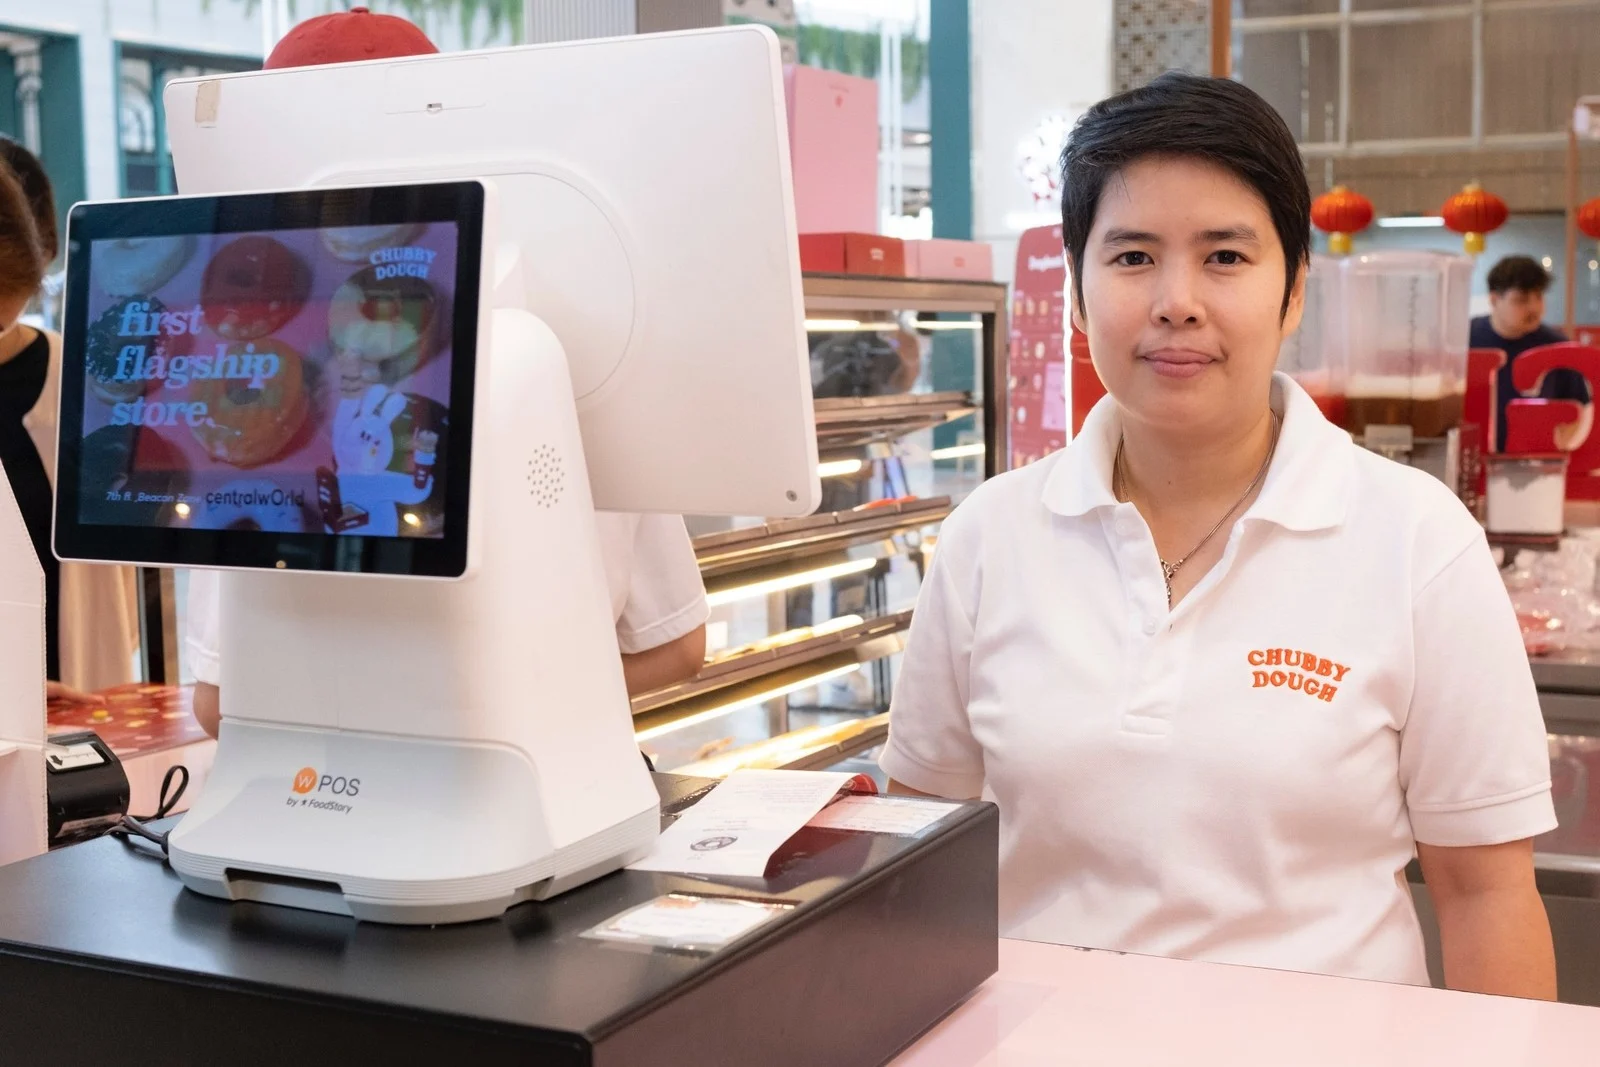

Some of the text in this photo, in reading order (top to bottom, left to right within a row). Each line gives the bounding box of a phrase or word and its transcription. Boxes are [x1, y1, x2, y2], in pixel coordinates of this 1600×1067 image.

[369, 247, 437, 265] CHUBBY
[375, 263, 428, 280] DOUGH
[119, 302, 204, 337] first
[116, 343, 279, 390] flagship
[1247, 648, 1351, 681] CHUBBY
[1252, 670, 1337, 702] DOUGH
[318, 775, 360, 796] POS
[286, 797, 353, 814] by FoodStory
